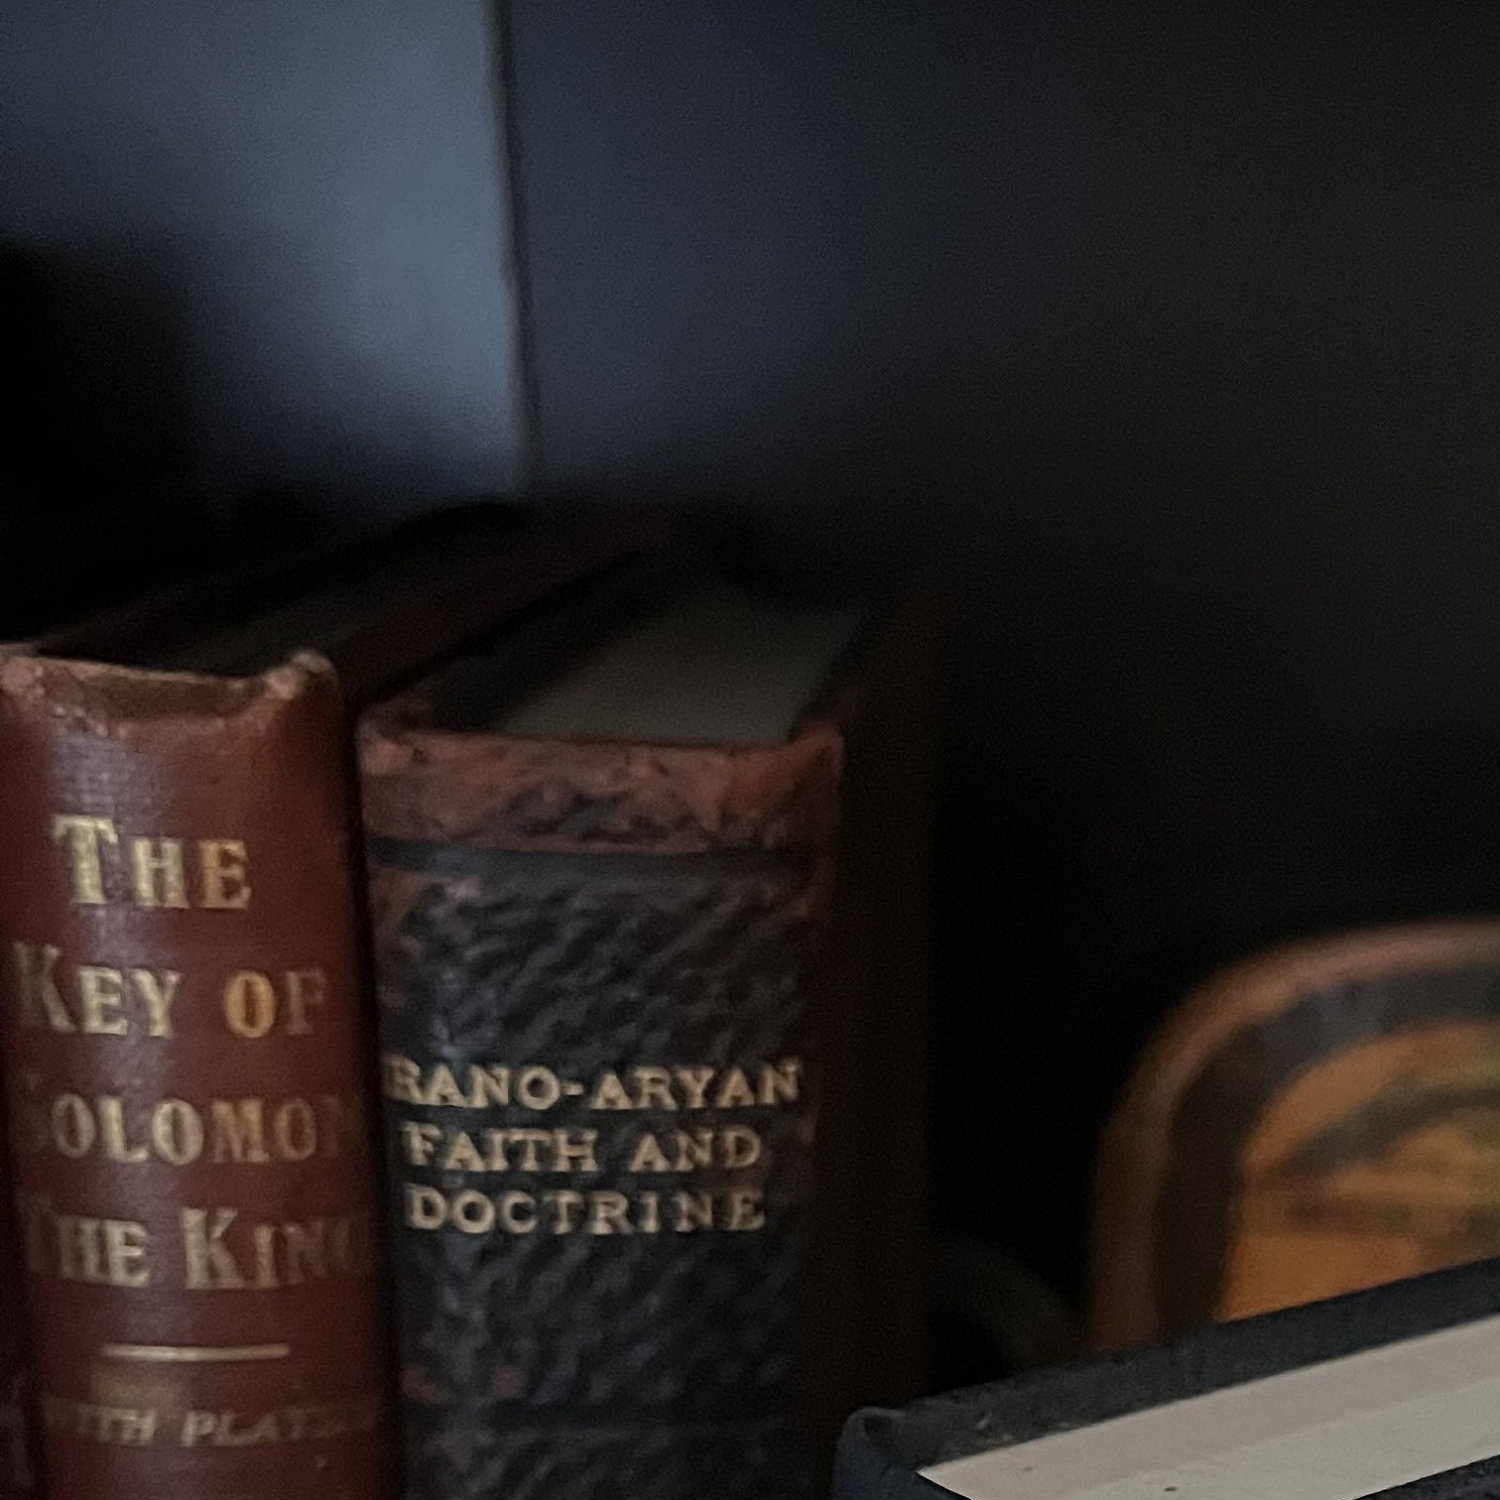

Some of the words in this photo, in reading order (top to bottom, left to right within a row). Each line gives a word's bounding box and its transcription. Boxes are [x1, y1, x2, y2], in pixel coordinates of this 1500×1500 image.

[52, 813, 253, 910] THE
[14, 940, 184, 1038] KEY
[225, 968, 328, 1038] OF
[22, 1092, 358, 1166] OLOMO
[402, 1120, 599, 1172] FAITH
[629, 1122, 763, 1172] AND
[405, 1182, 767, 1236] DOCTRINE
